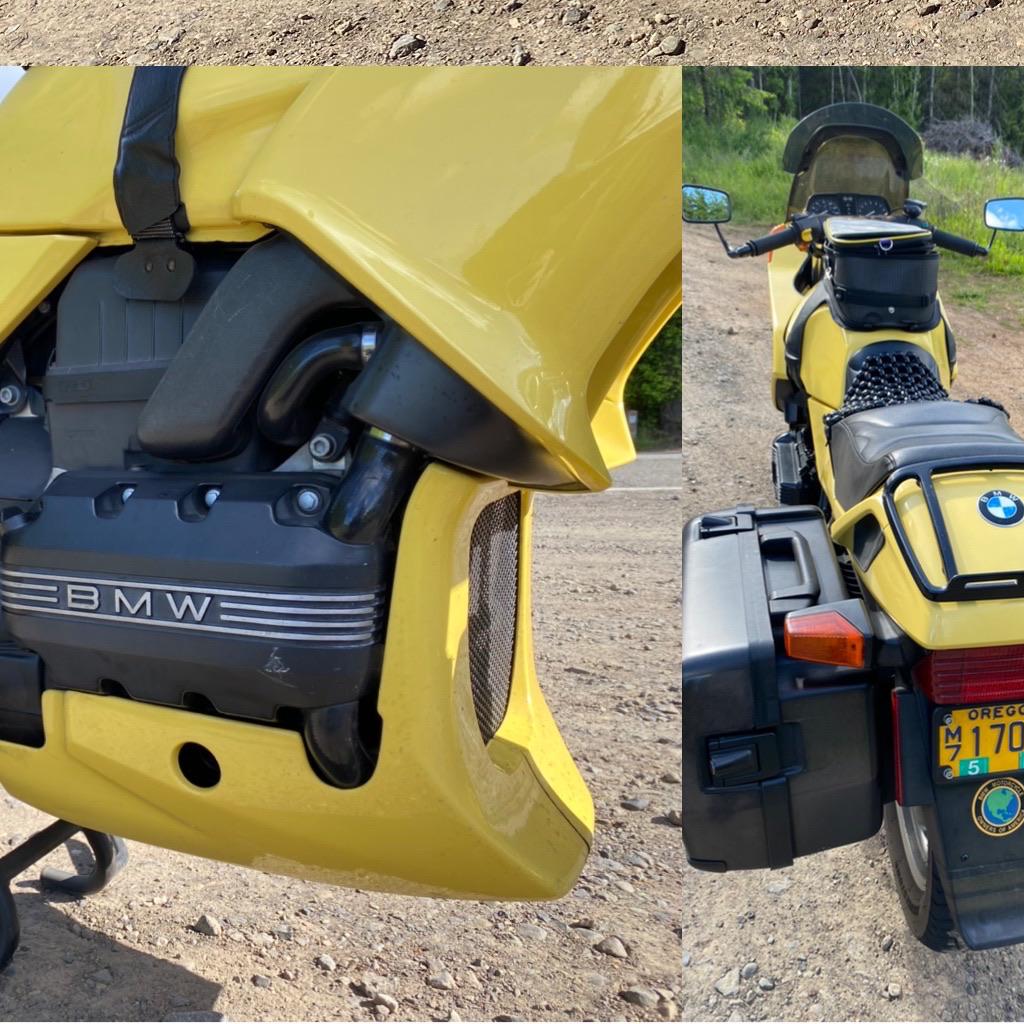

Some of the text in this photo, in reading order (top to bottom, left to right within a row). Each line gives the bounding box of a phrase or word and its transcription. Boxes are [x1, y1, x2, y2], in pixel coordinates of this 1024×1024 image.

[980, 490, 1019, 503] BMW
[66, 583, 211, 622] BMW
[967, 760, 980, 775] 5
